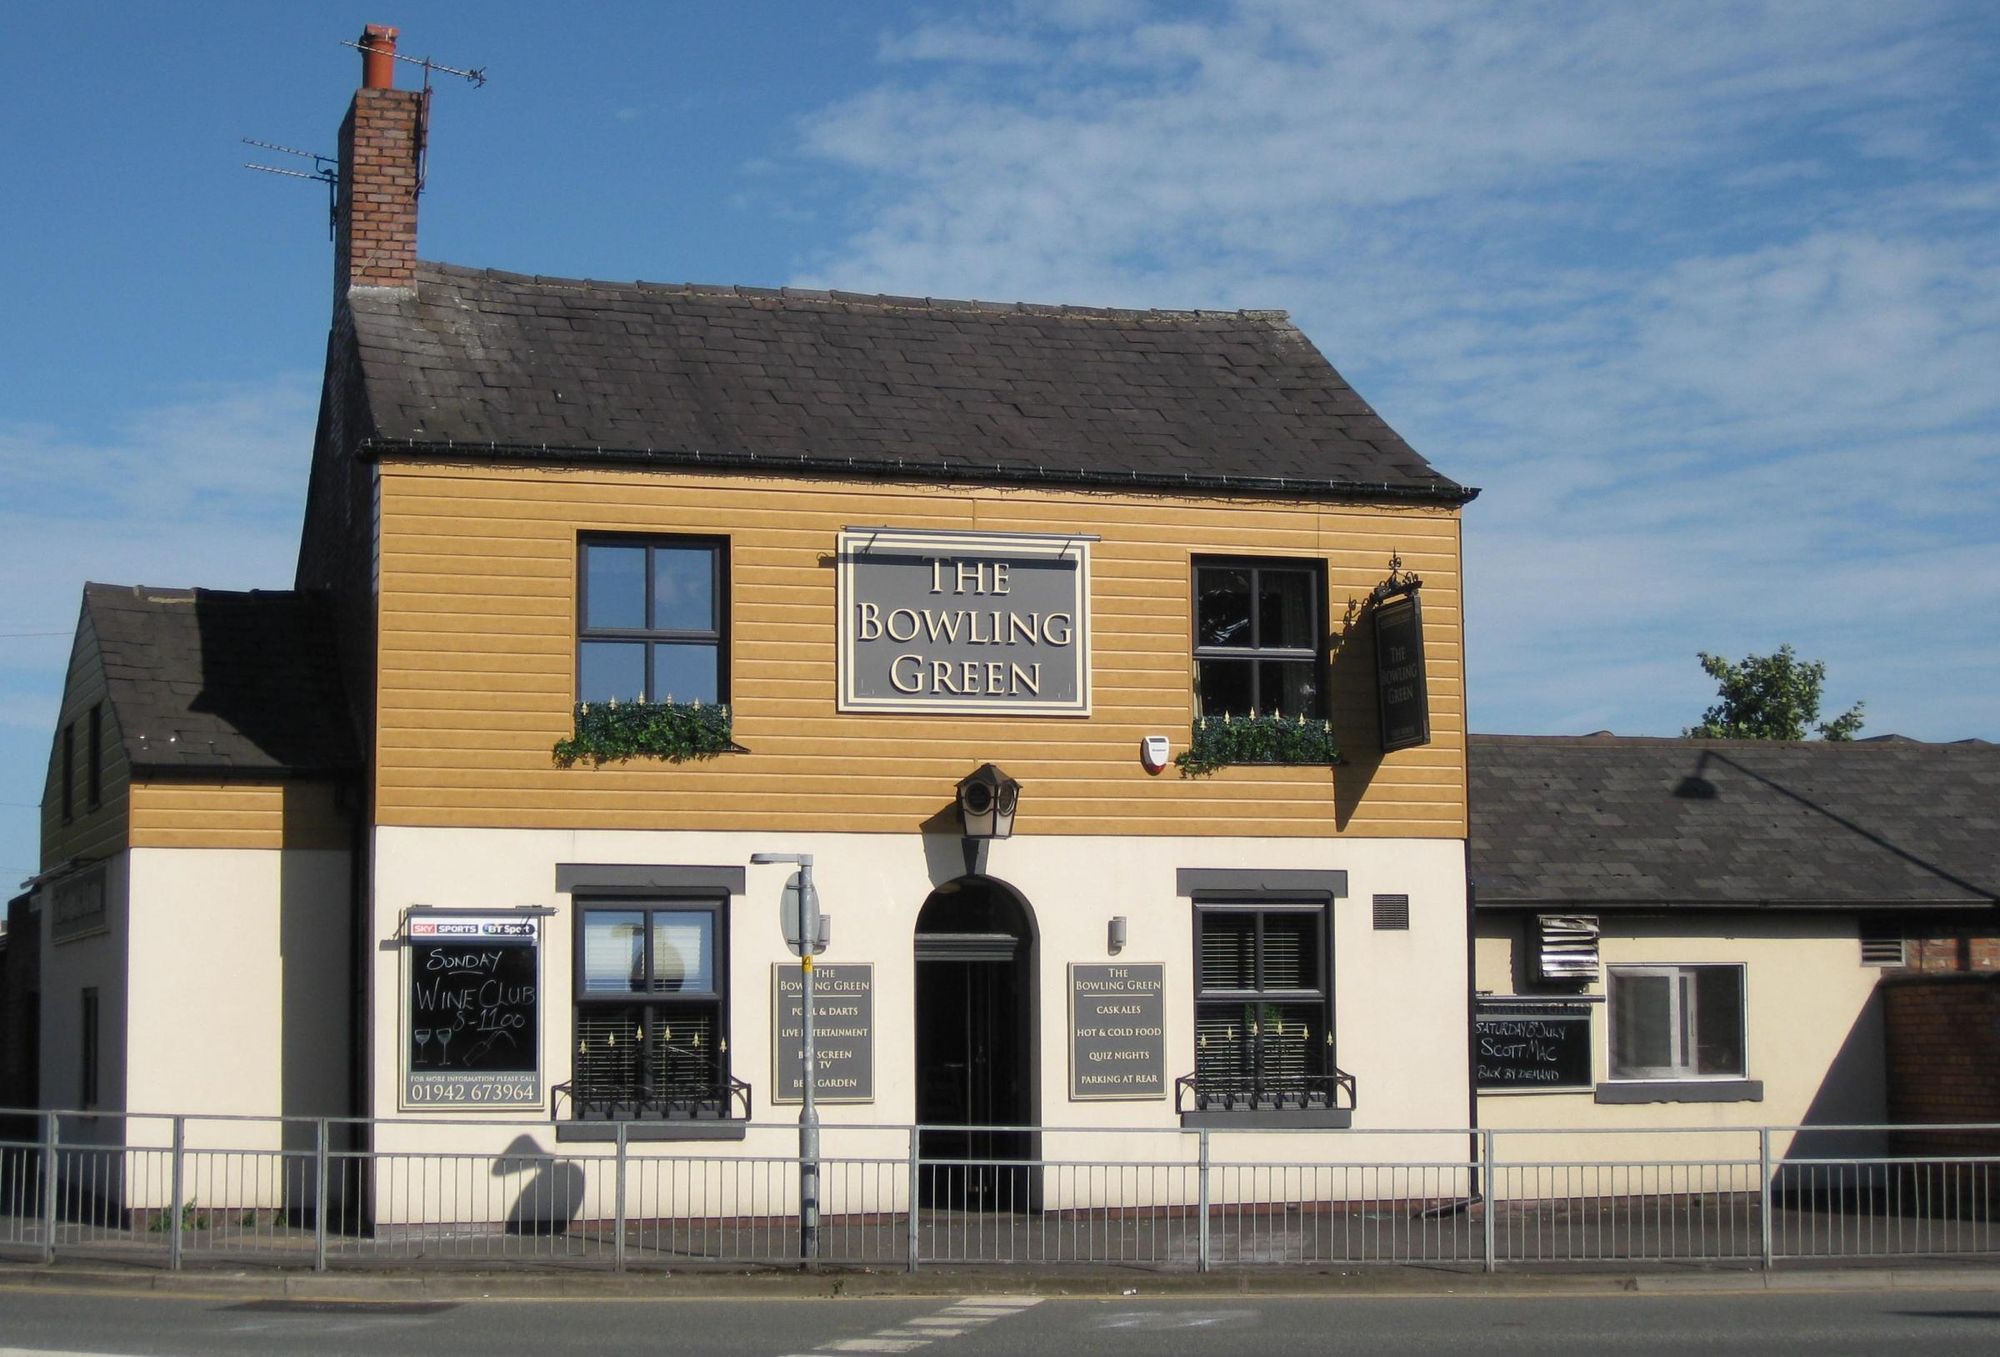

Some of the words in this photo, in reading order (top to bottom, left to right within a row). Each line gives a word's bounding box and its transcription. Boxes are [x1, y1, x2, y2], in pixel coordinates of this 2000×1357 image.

[922, 556, 1011, 595] THE
[857, 602, 1072, 645] BOWLING
[890, 655, 1041, 695] GREEN
[414, 925, 433, 933] SKY
[438, 925, 477, 933] SPORTS
[488, 925, 503, 933] BT
[813, 968, 836, 978] THE
[1108, 968, 1128, 978] THE
[781, 981, 831, 991] BOWNG
[834, 980, 870, 991] GREEN
[1076, 980, 1124, 991] BOWLING
[1127, 980, 1161, 990] GREEN
[416, 977, 477, 1011] WINE
[479, 979, 536, 1009] CLUB
[791, 1007, 817, 1016] POL
[819, 1007, 827, 1016] &
[829, 1007, 858, 1016] DARTS
[1096, 1006, 1120, 1014] CASK
[1121, 1006, 1141, 1014] ALES
[782, 1028, 799, 1037] LIVE
[1077, 1028, 1096, 1037] HOT
[1099, 1028, 1106, 1037] &
[1107, 1028, 1133, 1036] COLD
[1135, 1028, 1161, 1036] FOOD
[1476, 1022, 1526, 1037] SATURDAY
[1536, 1022, 1566, 1039] JULY
[1481, 1037, 1526, 1059] SCOTT
[1526, 1039, 1557, 1061] MAC
[816, 1051, 852, 1059] SCREEN
[1089, 1052, 1113, 1061] QUIZ
[1114, 1051, 1150, 1060] NIGHTS
[819, 1061, 832, 1069] TV
[1505, 1068, 1516, 1080] BY
[1518, 1068, 1559, 1080] DEMAND
[817, 1079, 857, 1087] GARDEN
[1081, 1075, 1120, 1084] PARKING
[1121, 1075, 1133, 1083] AT
[1135, 1075, 1158, 1083] REAR
[412, 1084, 466, 1101] 01942
[471, 1084, 534, 1101] 673964
